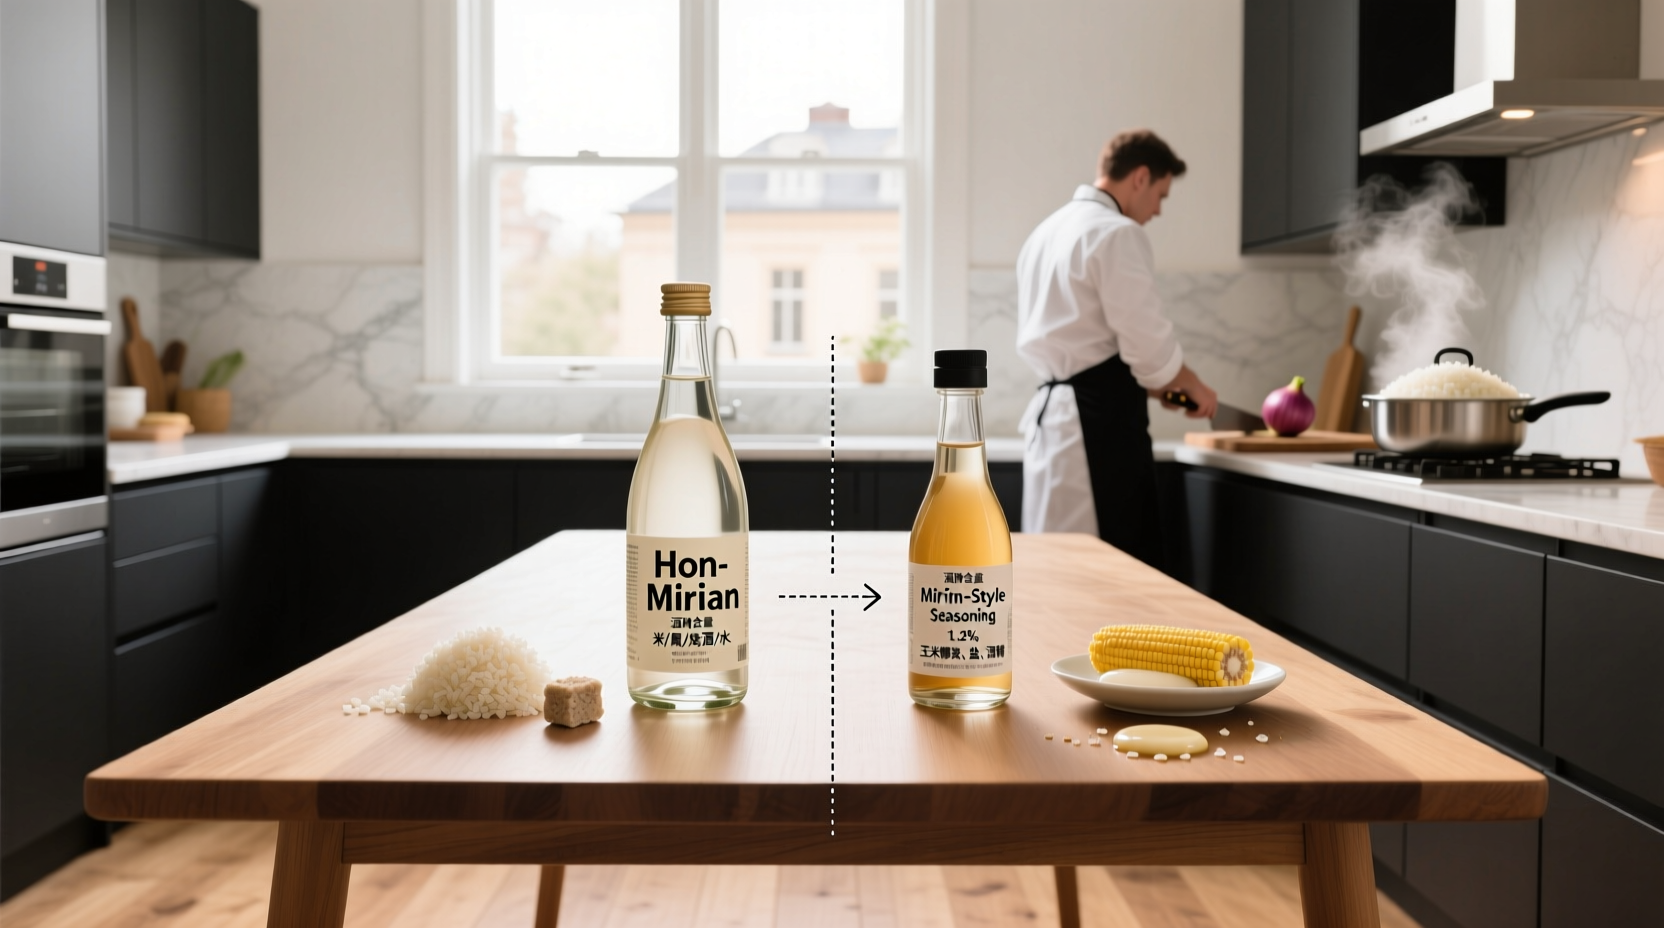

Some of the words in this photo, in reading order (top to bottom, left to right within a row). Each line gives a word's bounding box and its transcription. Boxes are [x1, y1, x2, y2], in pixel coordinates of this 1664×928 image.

[655, 550, 728, 578] Hon-
[647, 582, 739, 611] Mirian
[930, 608, 996, 625] Seasoning
[947, 629, 980, 642] 1.2%
